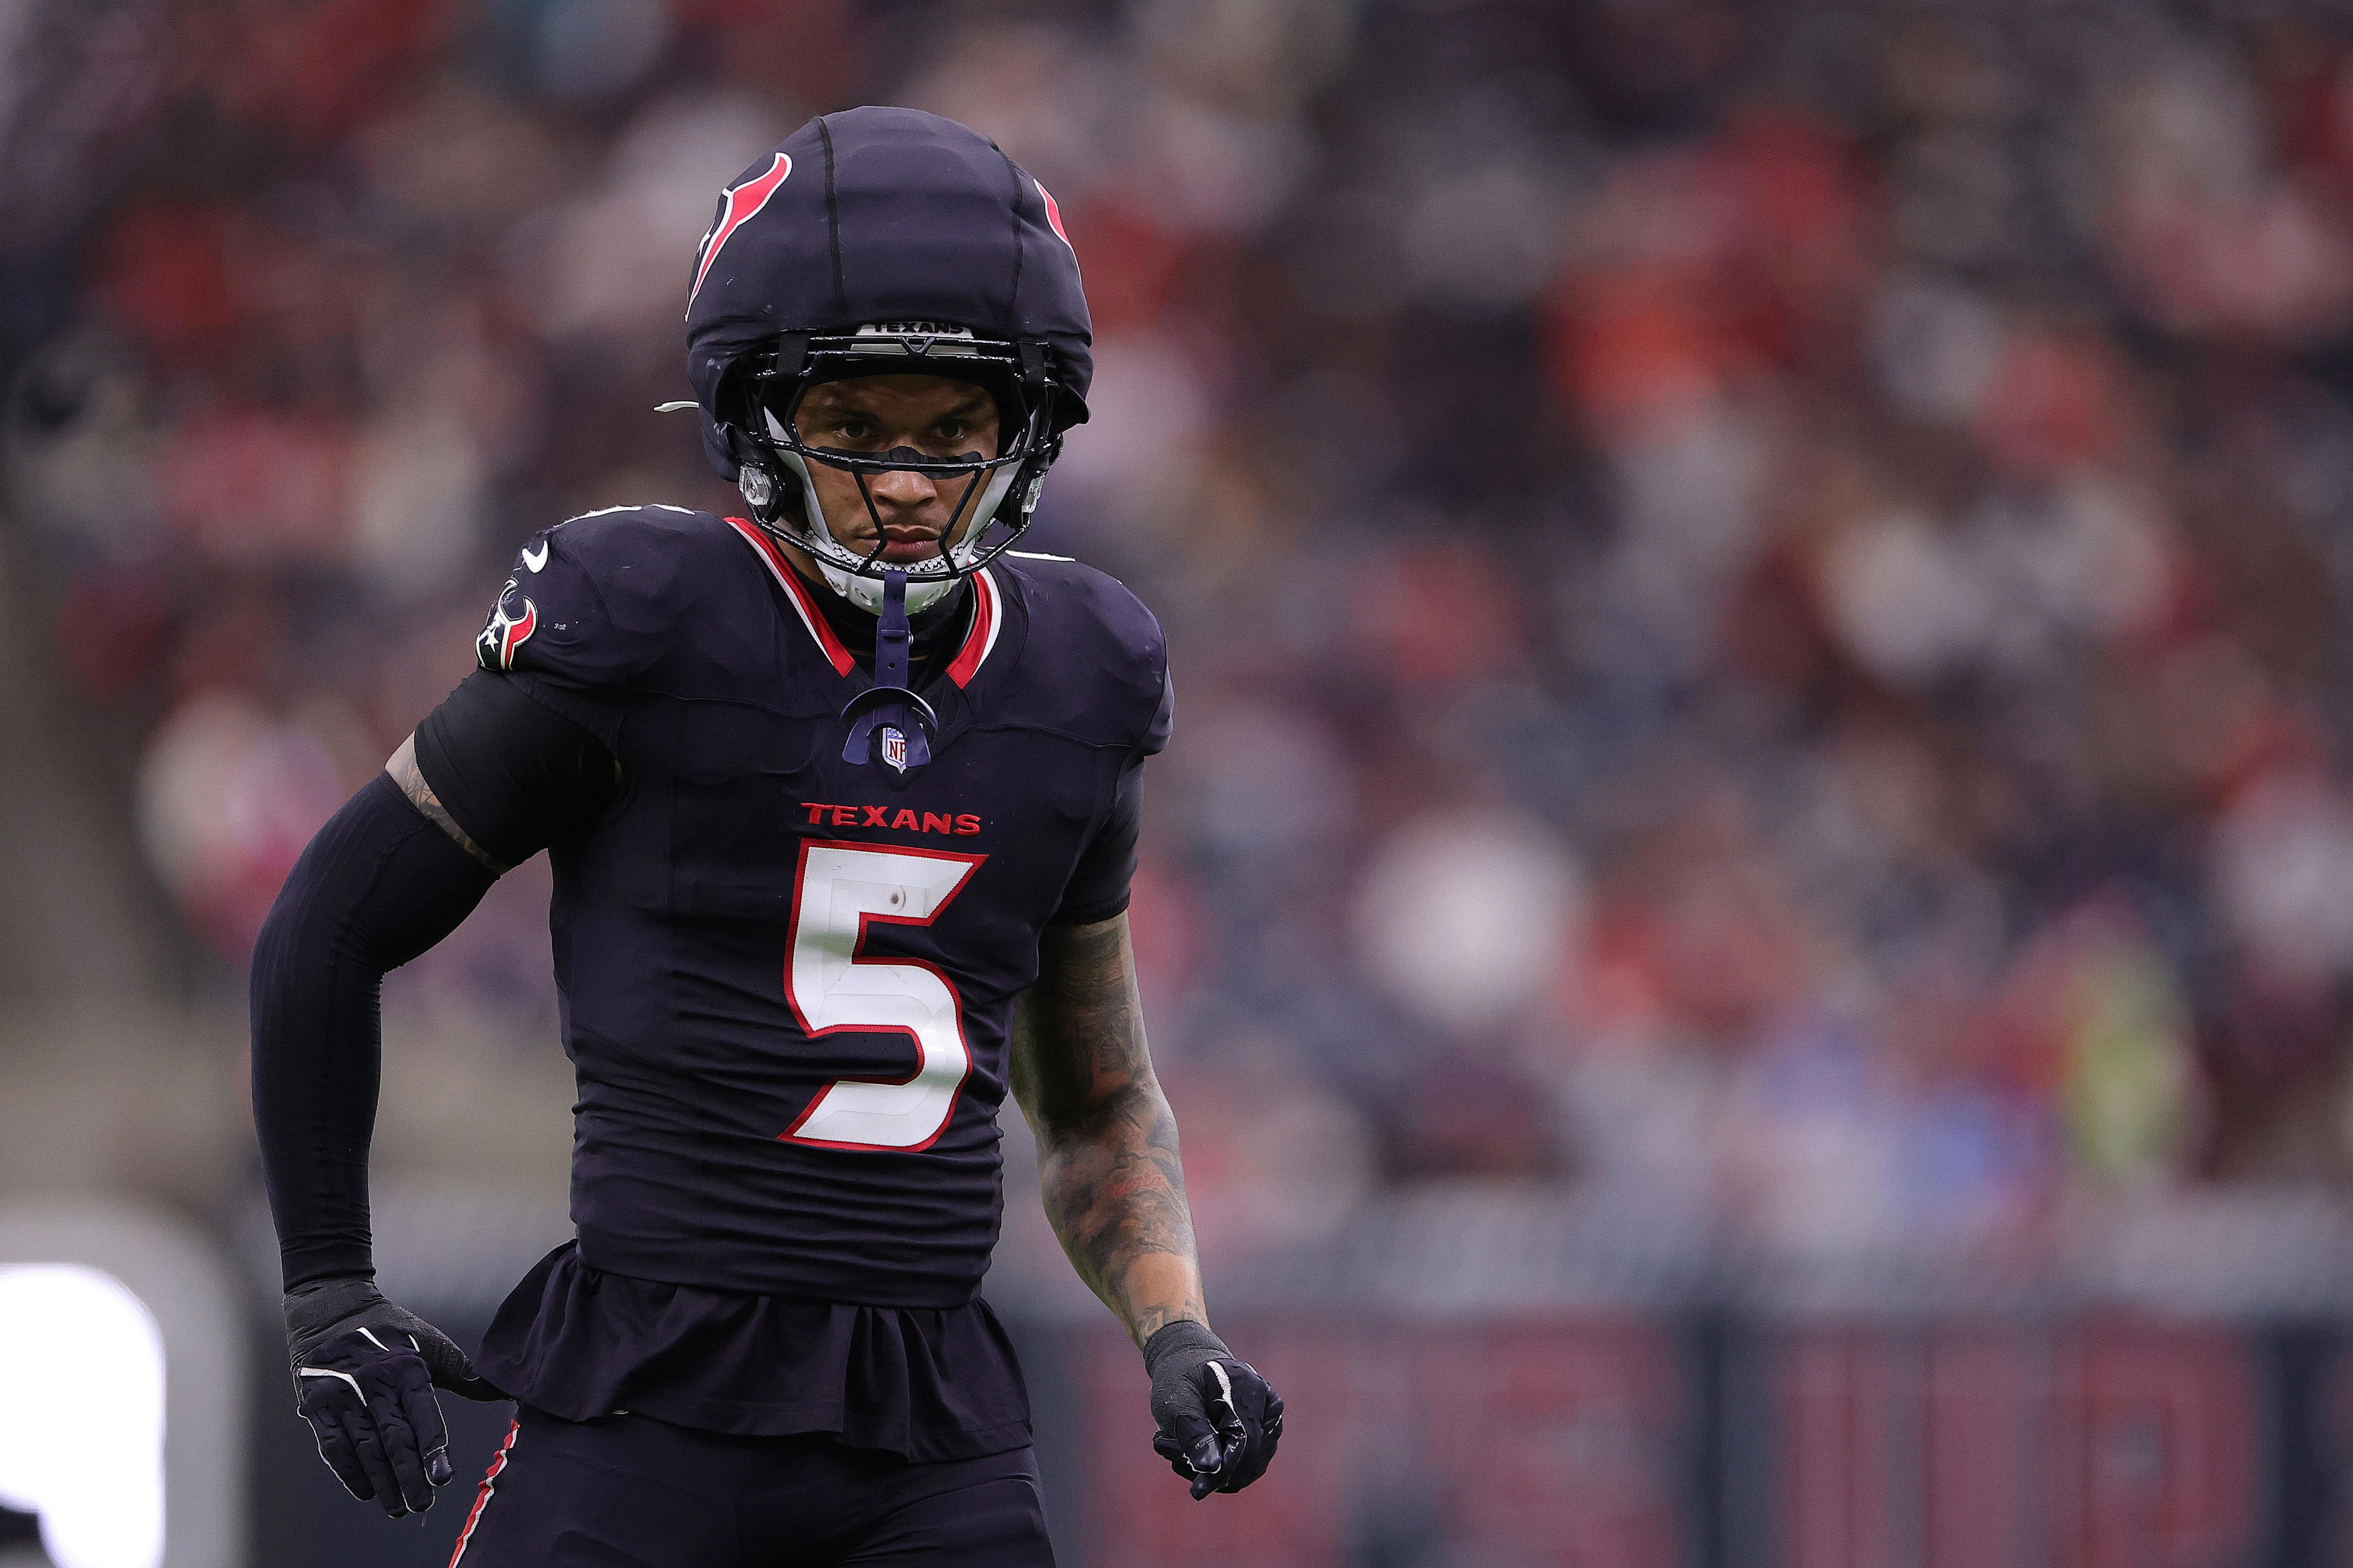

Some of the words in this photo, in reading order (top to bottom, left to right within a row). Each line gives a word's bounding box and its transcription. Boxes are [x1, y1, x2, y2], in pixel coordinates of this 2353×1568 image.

[874, 322, 964, 333] TEXANS
[889, 740, 906, 762] NF
[800, 802, 981, 836] TEXANS
[776, 838, 989, 1153] 5
